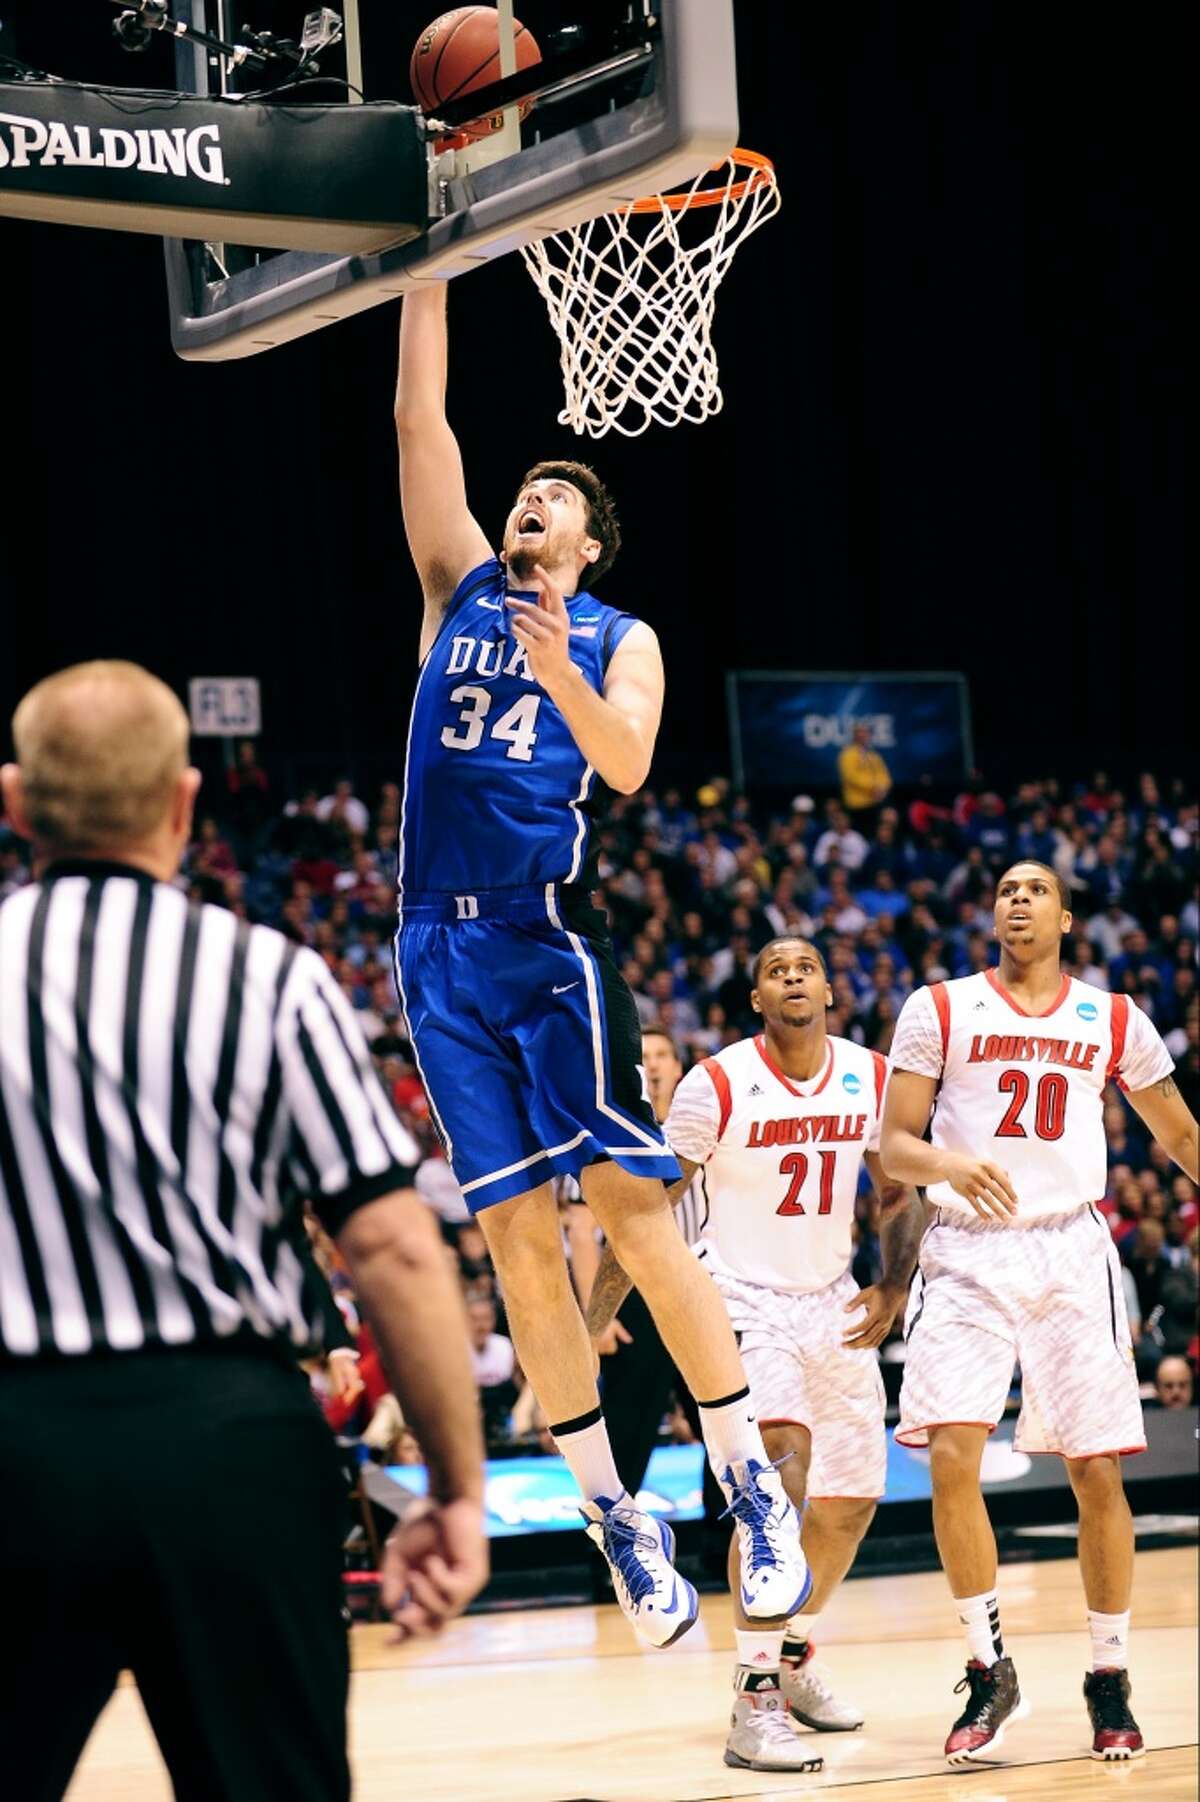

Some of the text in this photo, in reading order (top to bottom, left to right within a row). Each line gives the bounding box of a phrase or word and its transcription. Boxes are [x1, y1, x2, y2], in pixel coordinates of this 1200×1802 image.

[445, 636, 584, 682] DUK
[440, 685, 541, 762] 34
[453, 895, 480, 919] D
[966, 1034, 1100, 1072] LOUISVILLE
[993, 1069, 1068, 1141] 20
[745, 1114, 868, 1148] LOUISVILLE
[775, 1150, 837, 1216] 21
